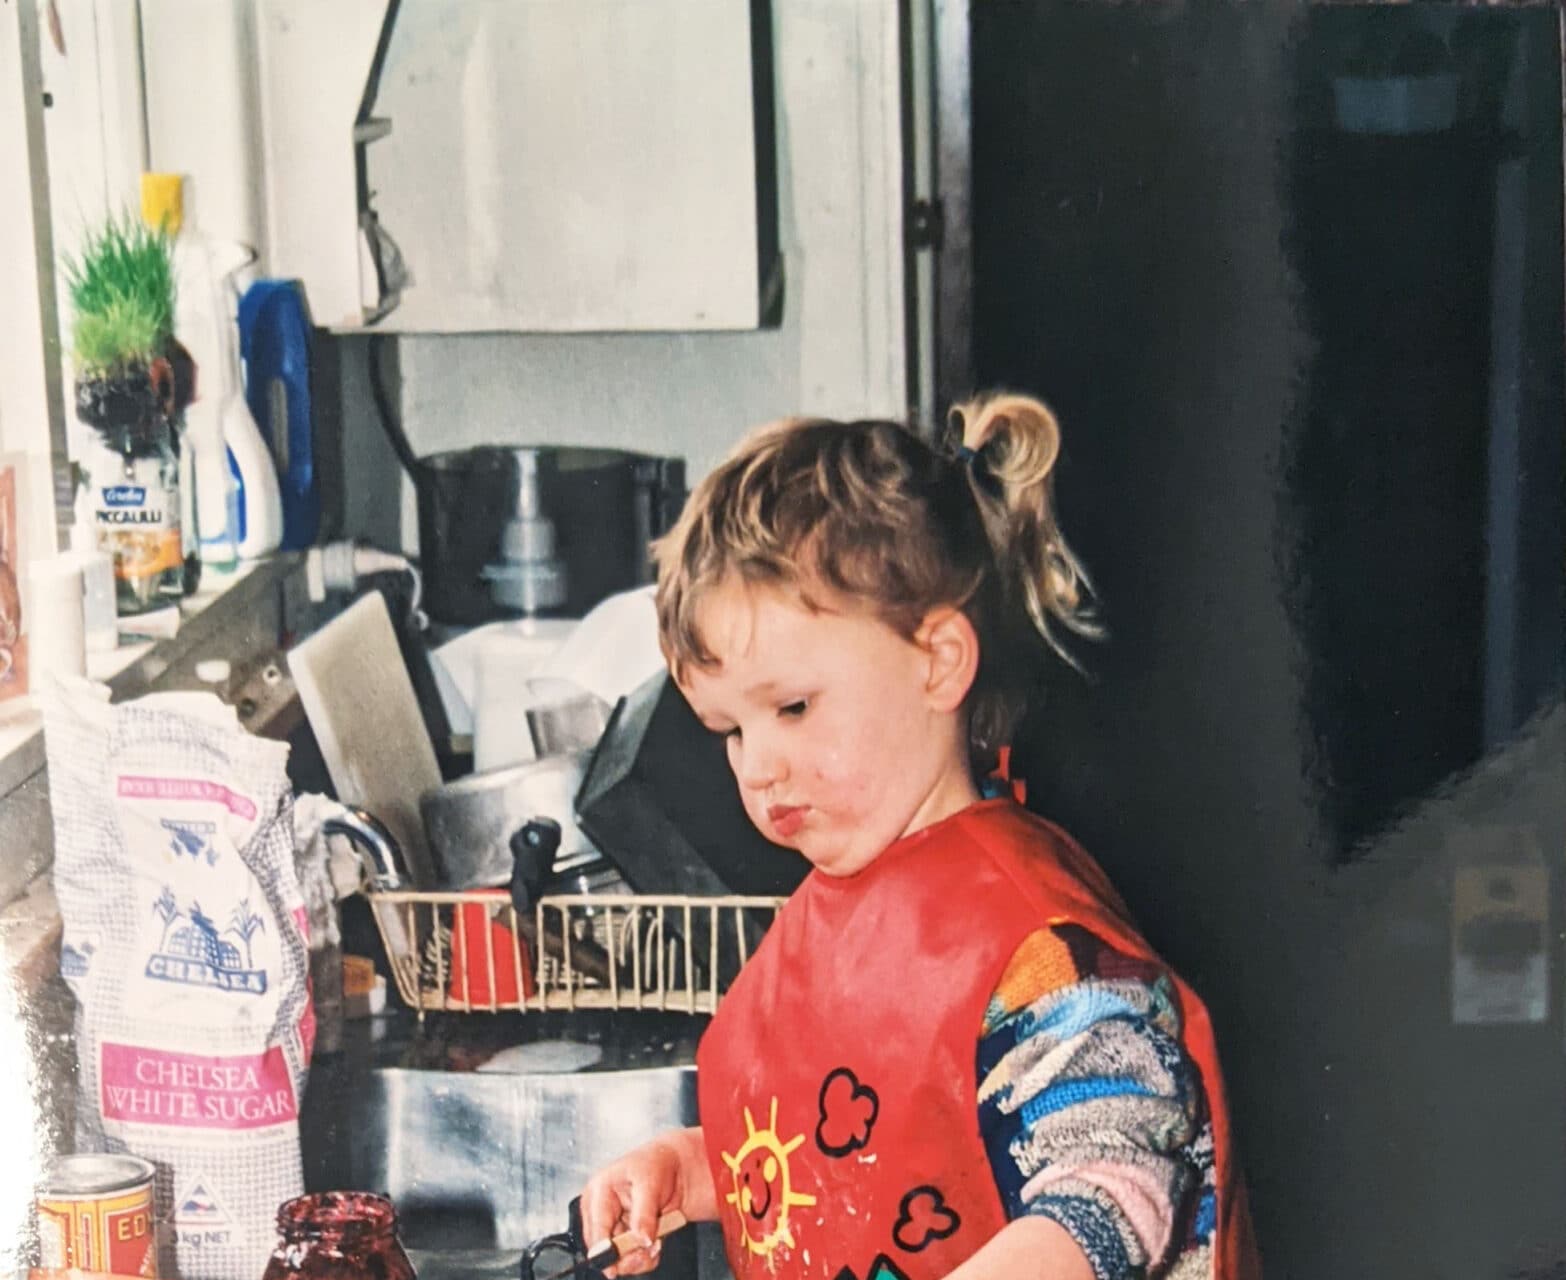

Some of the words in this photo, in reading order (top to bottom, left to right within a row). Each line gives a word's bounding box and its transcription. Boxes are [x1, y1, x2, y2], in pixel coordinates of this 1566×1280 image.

[136, 1056, 260, 1091] CHELSEA
[106, 1085, 199, 1118] WHITE
[204, 1089, 291, 1120] SUGAR
[182, 1231, 201, 1247] kg
[204, 1231, 233, 1244] NET
